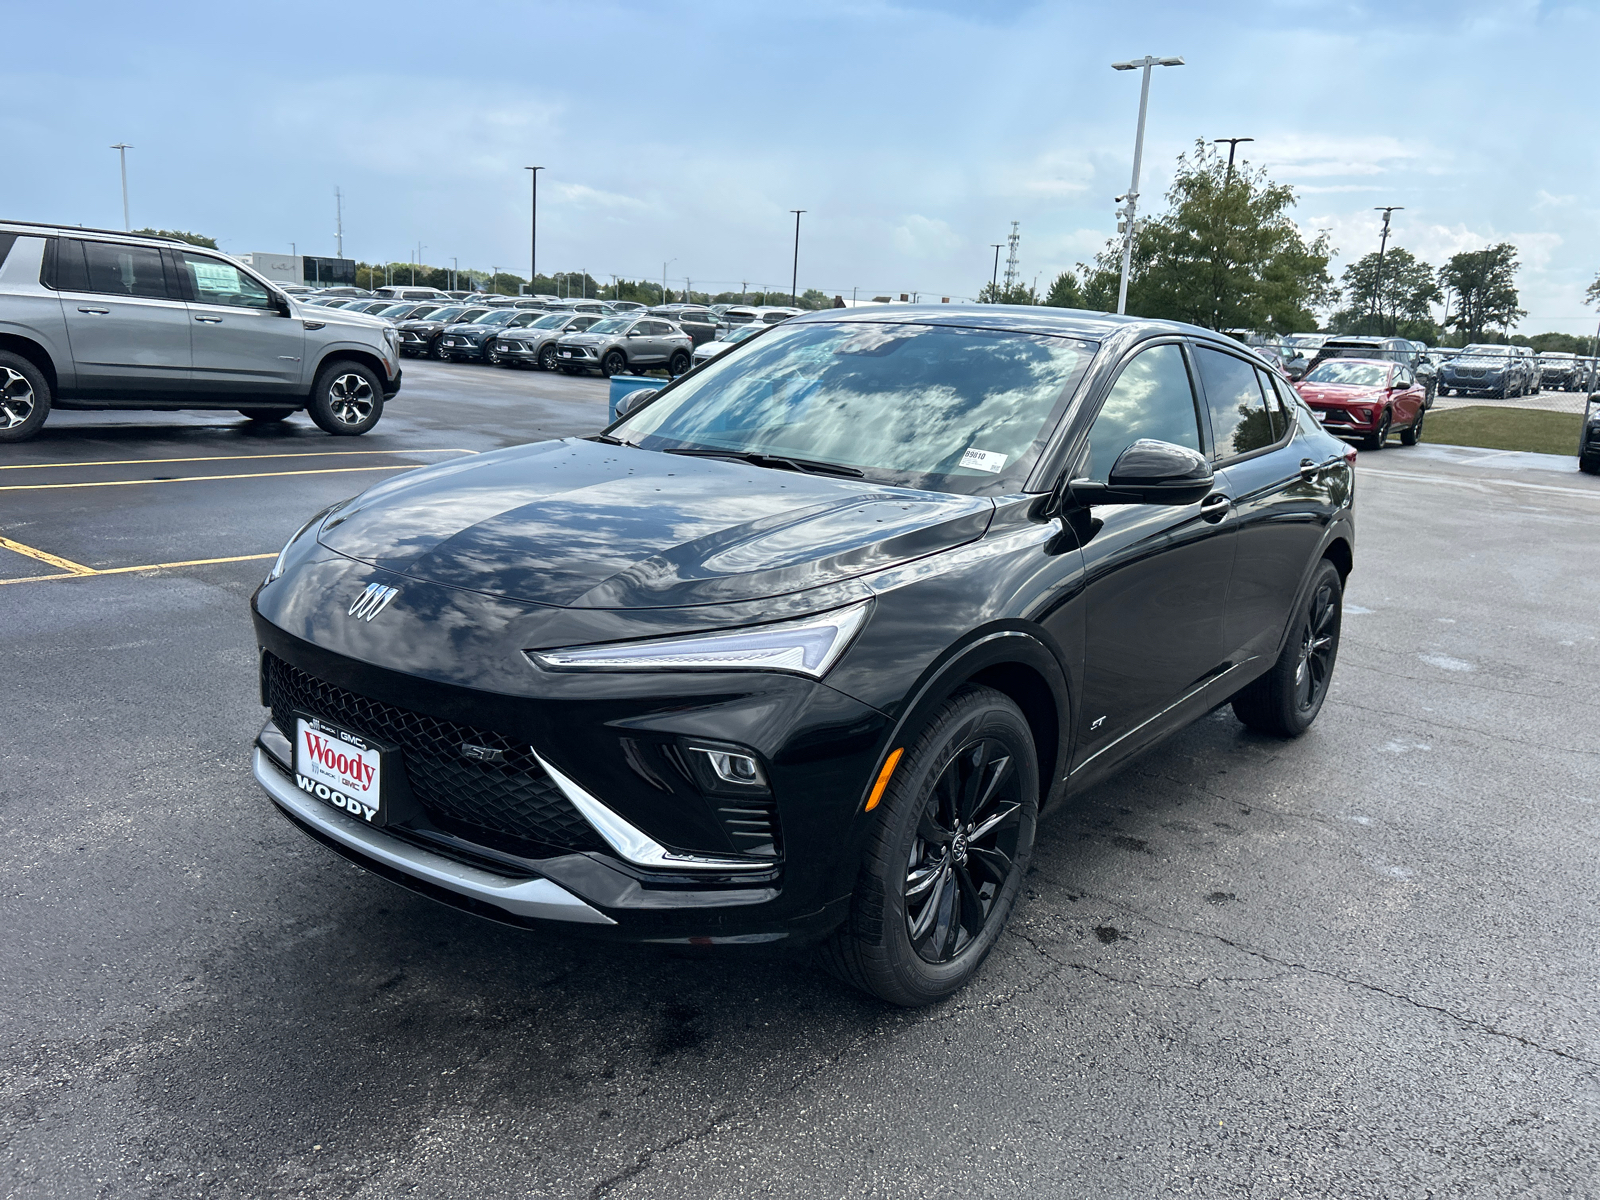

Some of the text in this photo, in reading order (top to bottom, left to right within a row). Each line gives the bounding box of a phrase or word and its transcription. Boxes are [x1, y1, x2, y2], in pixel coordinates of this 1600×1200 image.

[340, 731, 363, 746] GMC
[304, 730, 376, 791] Woody
[296, 773, 377, 822] WOODY
[341, 777, 360, 791] GMC
